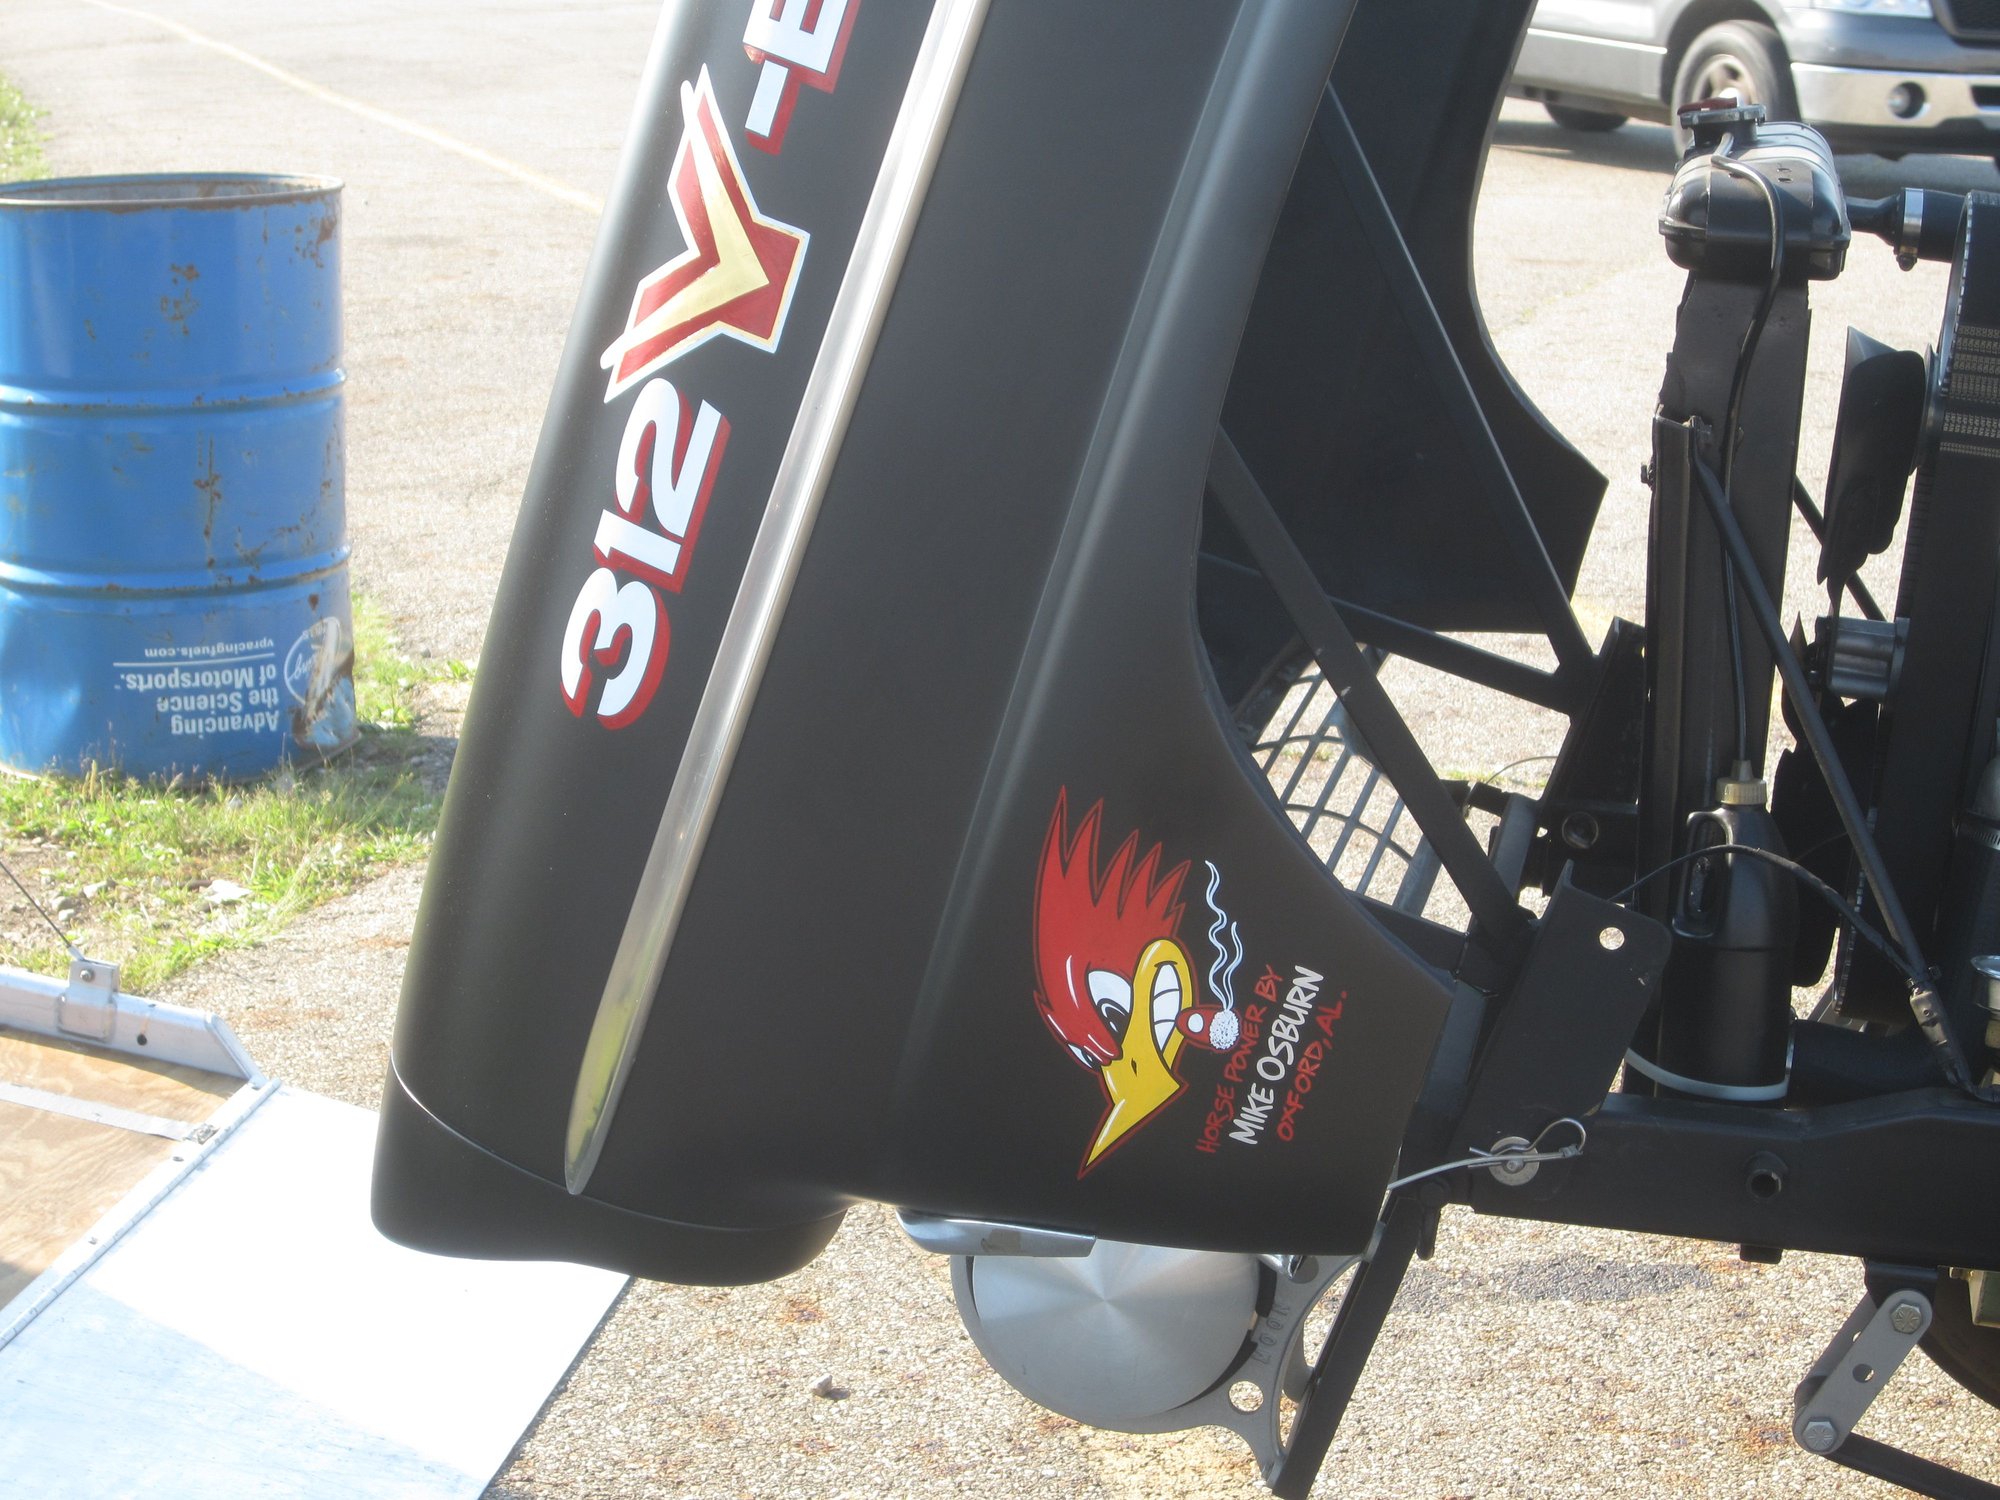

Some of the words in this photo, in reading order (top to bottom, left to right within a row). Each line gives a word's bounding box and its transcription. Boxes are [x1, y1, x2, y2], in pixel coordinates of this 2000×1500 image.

[561, 377, 731, 730] 312
[145, 638, 274, 657] vpracingfuels.com
[120, 667, 254, 692] Motorsports.
[258, 664, 277, 683] of
[156, 694, 242, 715] Science
[249, 687, 279, 708] the
[170, 710, 279, 739] Advancing
[1196, 1083, 1234, 1152] HORSE
[1224, 1004, 1268, 1083] POWER
[1255, 964, 1284, 1003] BY
[1229, 1082, 1275, 1145] MIKE
[1256, 965, 1325, 1082] OSBURN
